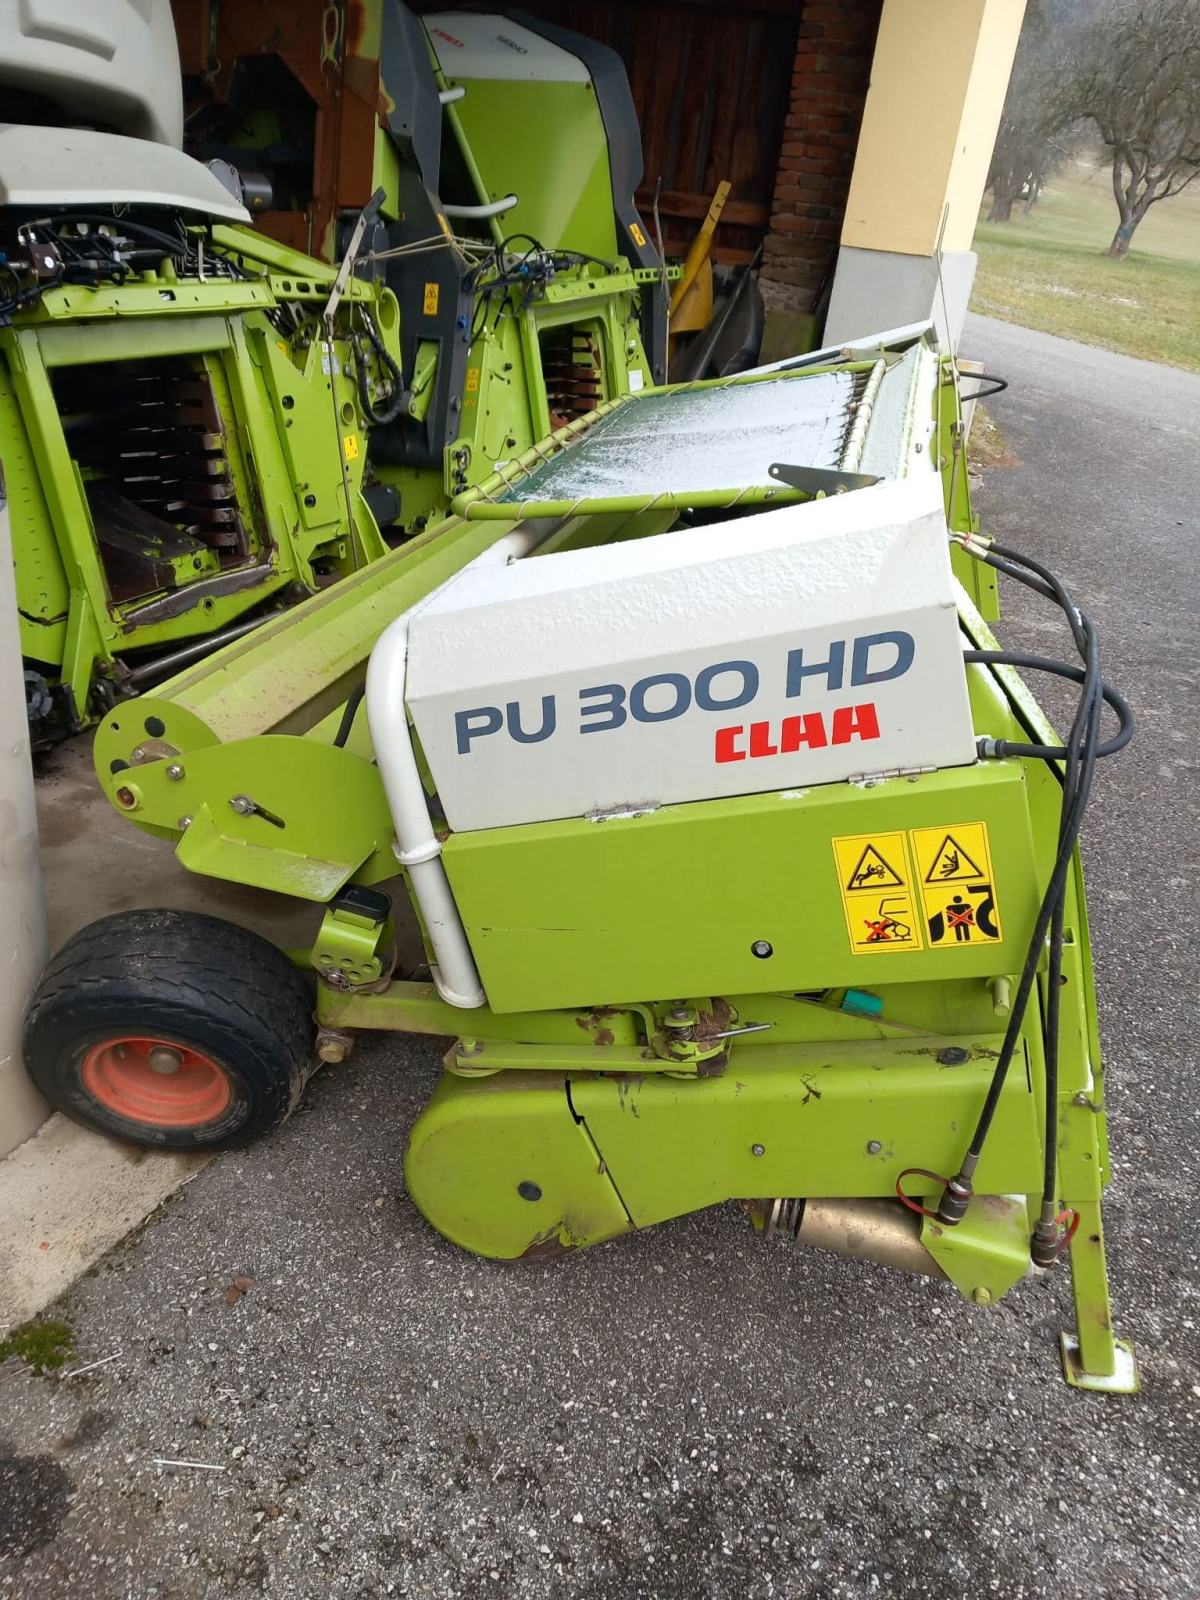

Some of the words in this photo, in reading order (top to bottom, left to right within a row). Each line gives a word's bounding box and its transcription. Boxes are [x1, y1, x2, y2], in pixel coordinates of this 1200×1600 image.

[454, 694, 557, 755] PU
[579, 660, 760, 735] 300
[786, 630, 916, 699] HD
[714, 702, 882, 764] CLAA
